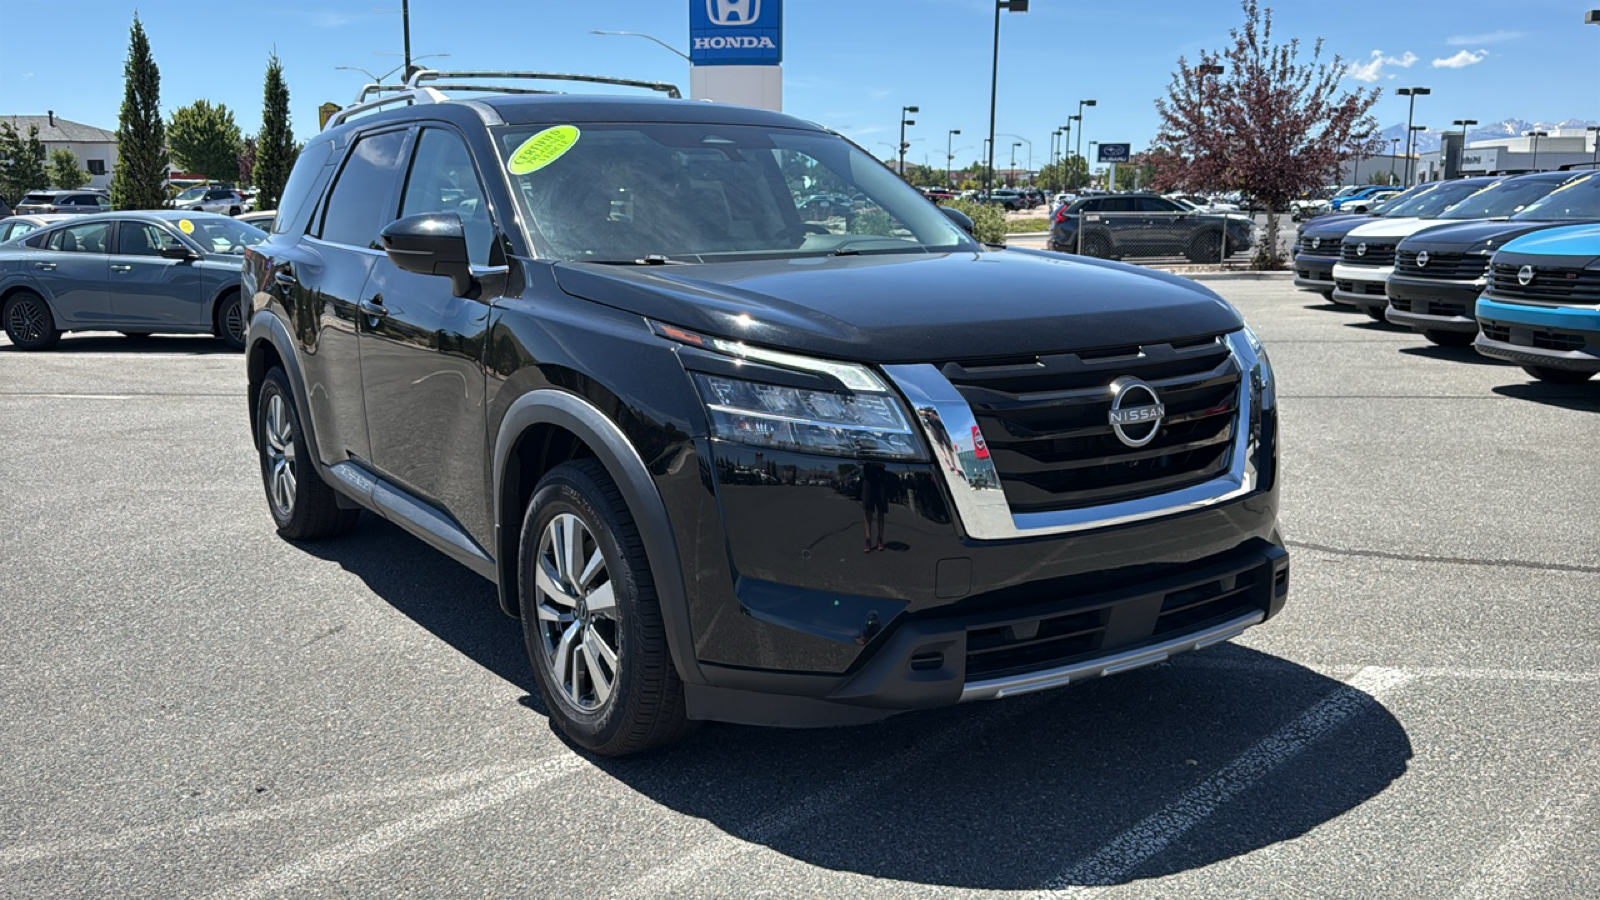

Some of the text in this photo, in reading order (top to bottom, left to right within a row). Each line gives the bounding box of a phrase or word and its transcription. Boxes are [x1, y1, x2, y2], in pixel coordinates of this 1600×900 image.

[693, 36, 776, 50] HONDA
[514, 129, 561, 165] CERTIFIED
[1110, 405, 1165, 422] NISSAN
